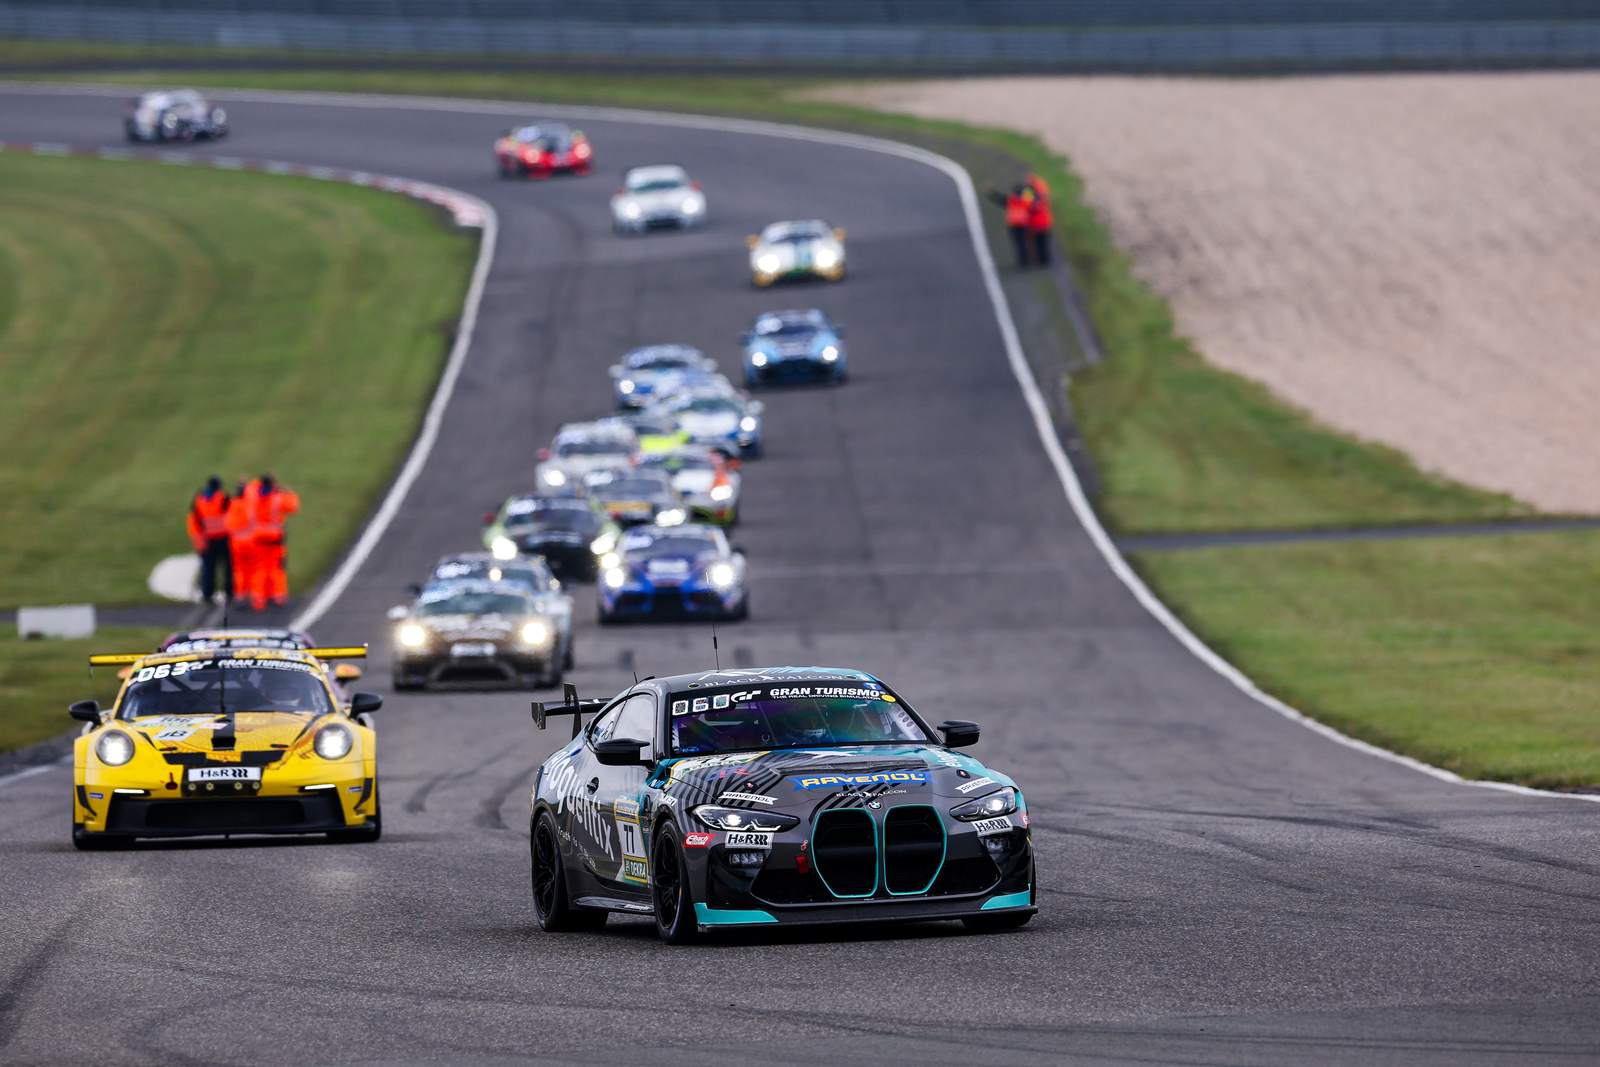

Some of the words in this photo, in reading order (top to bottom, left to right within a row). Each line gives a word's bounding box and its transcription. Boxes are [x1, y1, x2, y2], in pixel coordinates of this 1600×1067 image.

[257, 659, 311, 672] TURISMO
[769, 687, 811, 696] GRAN
[814, 687, 880, 697] TURISMO
[801, 772, 925, 787] RAVENOL
[724, 793, 771, 803] RAVENOL
[623, 824, 635, 854] 77
[727, 834, 754, 845] H&R
[630, 861, 647, 880] DEKRA
